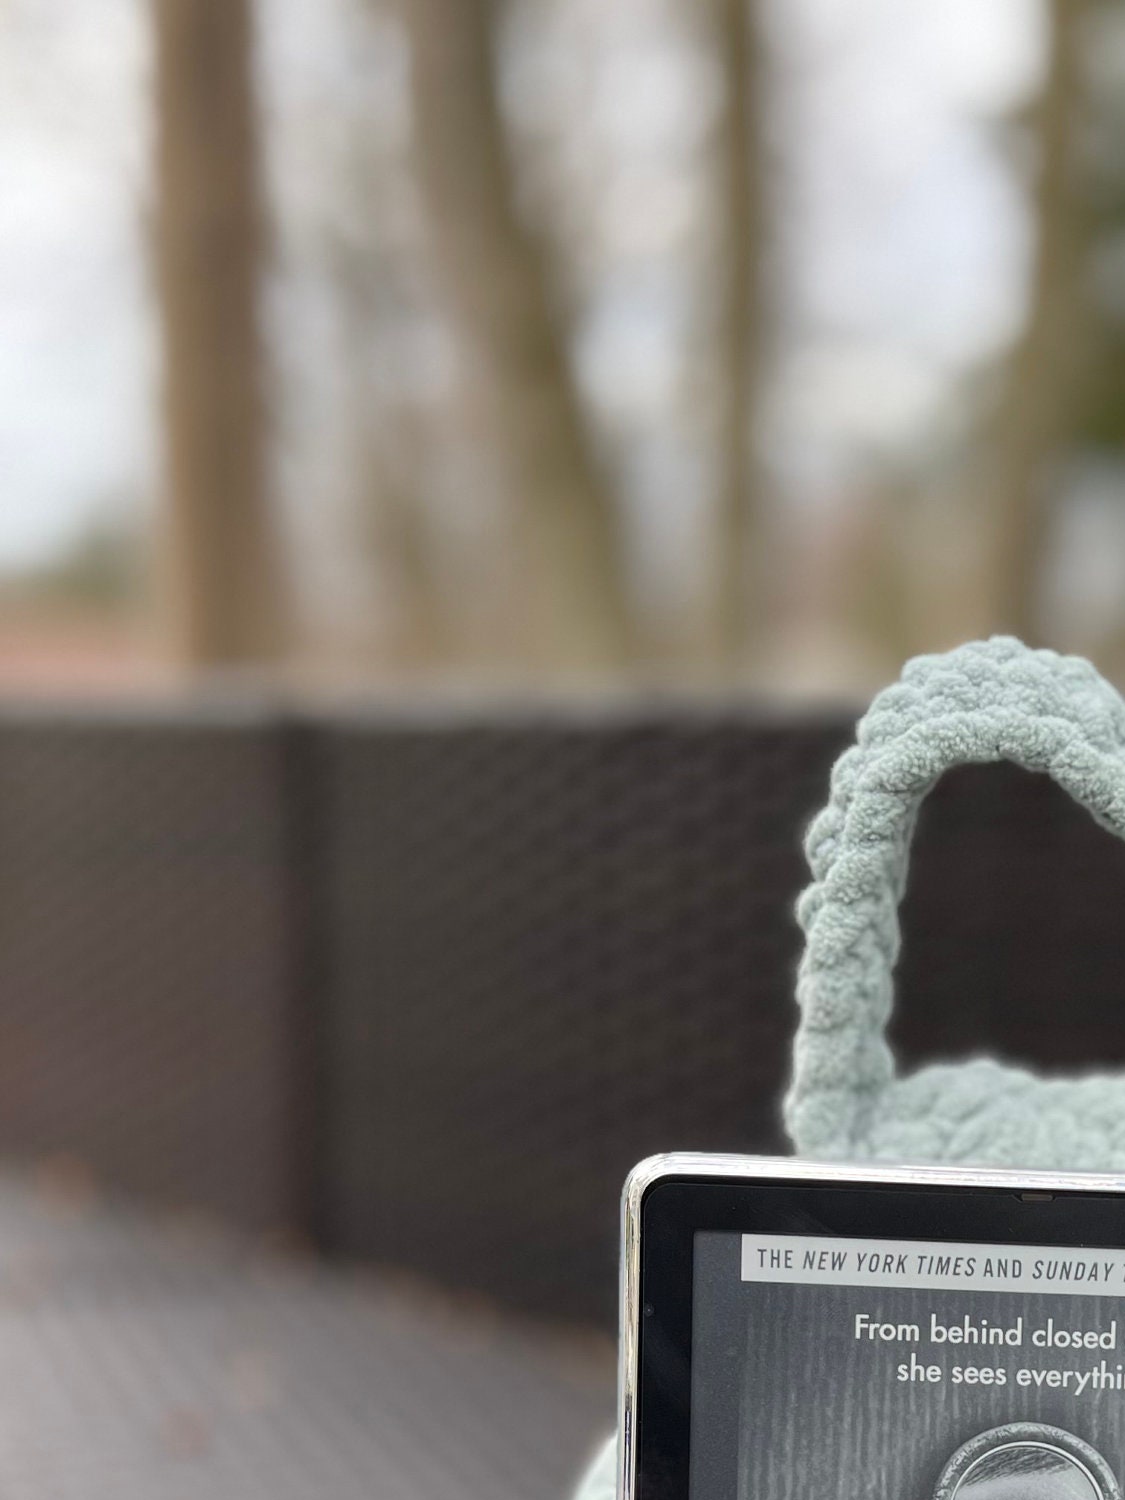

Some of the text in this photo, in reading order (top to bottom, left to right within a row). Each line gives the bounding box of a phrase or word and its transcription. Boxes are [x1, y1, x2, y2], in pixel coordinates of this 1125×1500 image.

[757, 1249, 793, 1268] THE
[802, 1250, 847, 1271] NEW
[857, 1253, 908, 1274] YORK
[917, 1255, 976, 1276] TIMES
[983, 1258, 1022, 1278] AND
[1032, 1260, 1114, 1282] SUNDAY
[854, 1314, 920, 1341] From
[931, 1313, 1022, 1345] behind
[1032, 1318, 1116, 1349] closed
[897, 1353, 942, 1382] she
[951, 1366, 1007, 1385] sees
